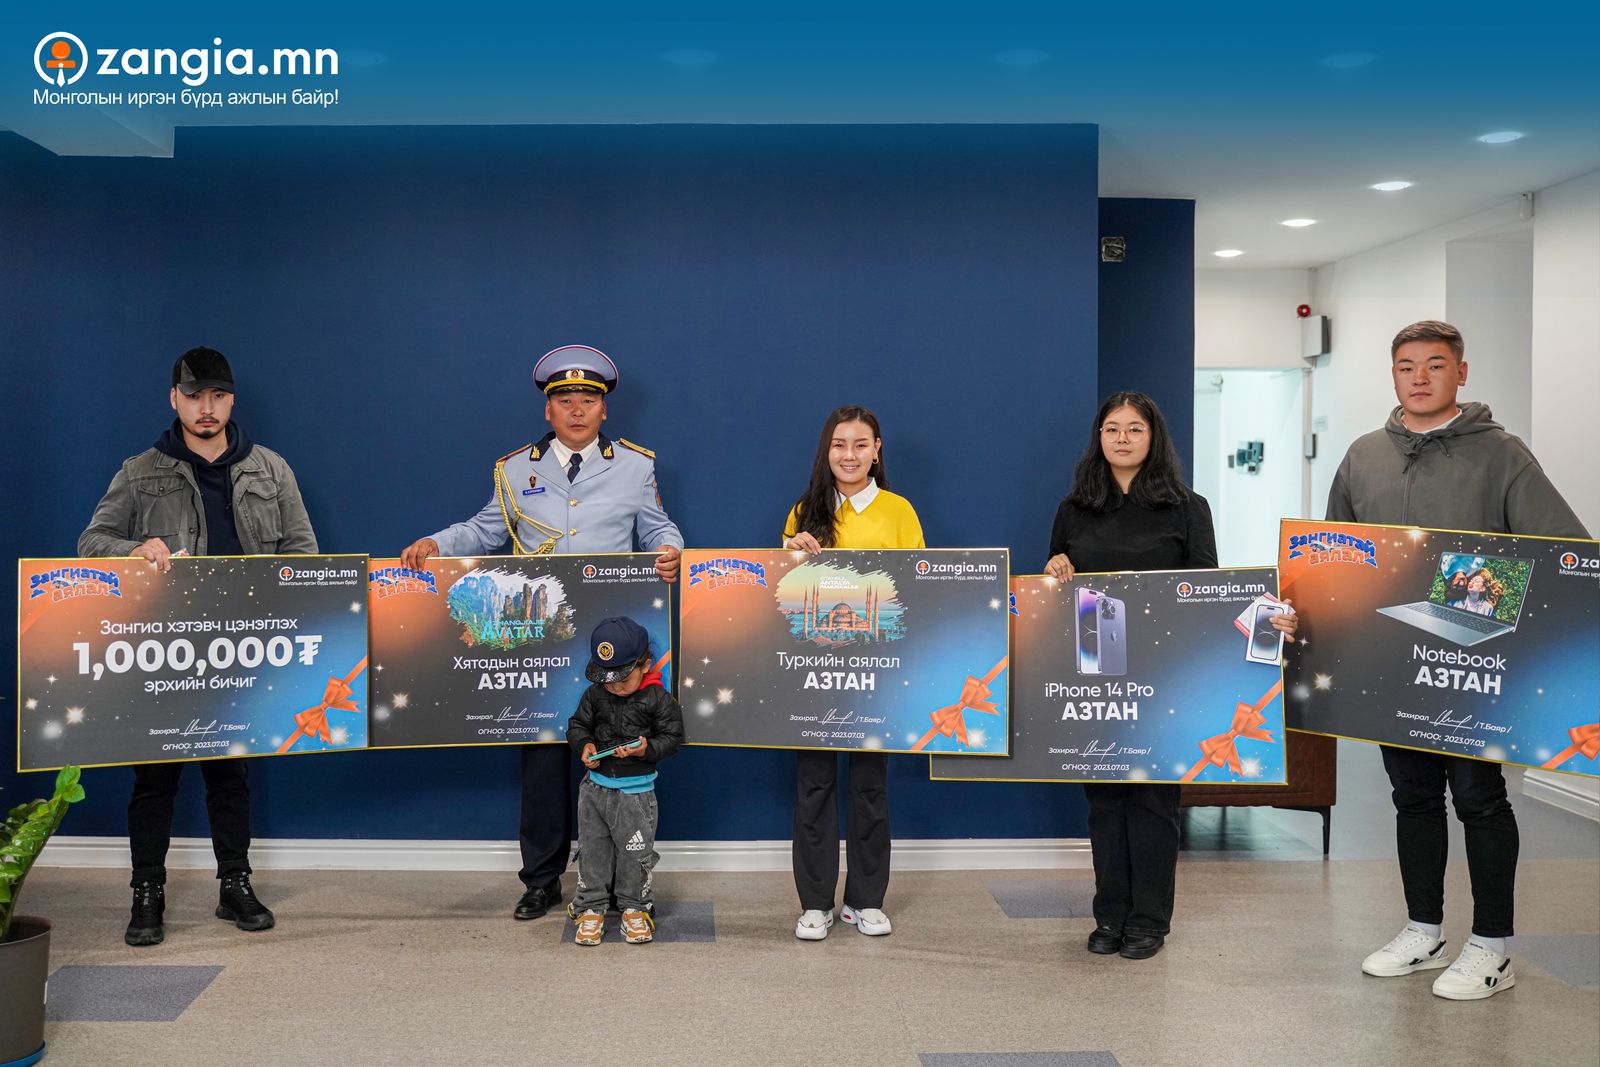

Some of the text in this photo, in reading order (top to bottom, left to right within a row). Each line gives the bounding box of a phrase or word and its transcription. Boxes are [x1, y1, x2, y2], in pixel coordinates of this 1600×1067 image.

[295, 567, 357, 580] zangia.mn
[932, 562, 997, 575] zangia.mn
[1194, 582, 1265, 596] zangia.mn
[100, 618, 298, 635] Зангиа хэтэвч цэнэглэх
[72, 634, 323, 681] 1,000,000₮
[453, 656, 570, 670] Хятадын аялал
[776, 651, 900, 670] Туркийн аялал
[1413, 644, 1507, 671] Notebook
[144, 675, 257, 695] эрхийн бичиг
[477, 671, 547, 690] АЗТАН
[803, 671, 875, 691] АЗТАН
[1414, 665, 1502, 696] АЗТАН
[1045, 682, 1154, 697] iPhone 14 Pro
[789, 714, 818, 722] Захирал
[1061, 701, 1138, 721] АЗТАН
[1396, 710, 1430, 721] Захирал
[149, 728, 180, 736] Захирал
[801, 730, 865, 739] ОГНОО: 2023.07.03
[1409, 729, 1486, 748] ОГНОО: 2023.07.03
[162, 740, 230, 751] ОГНОО: 2023.07.03
[1048, 747, 1079, 755] Захирал
[1061, 763, 1130, 771] ОГНОО: 2023.07.03
